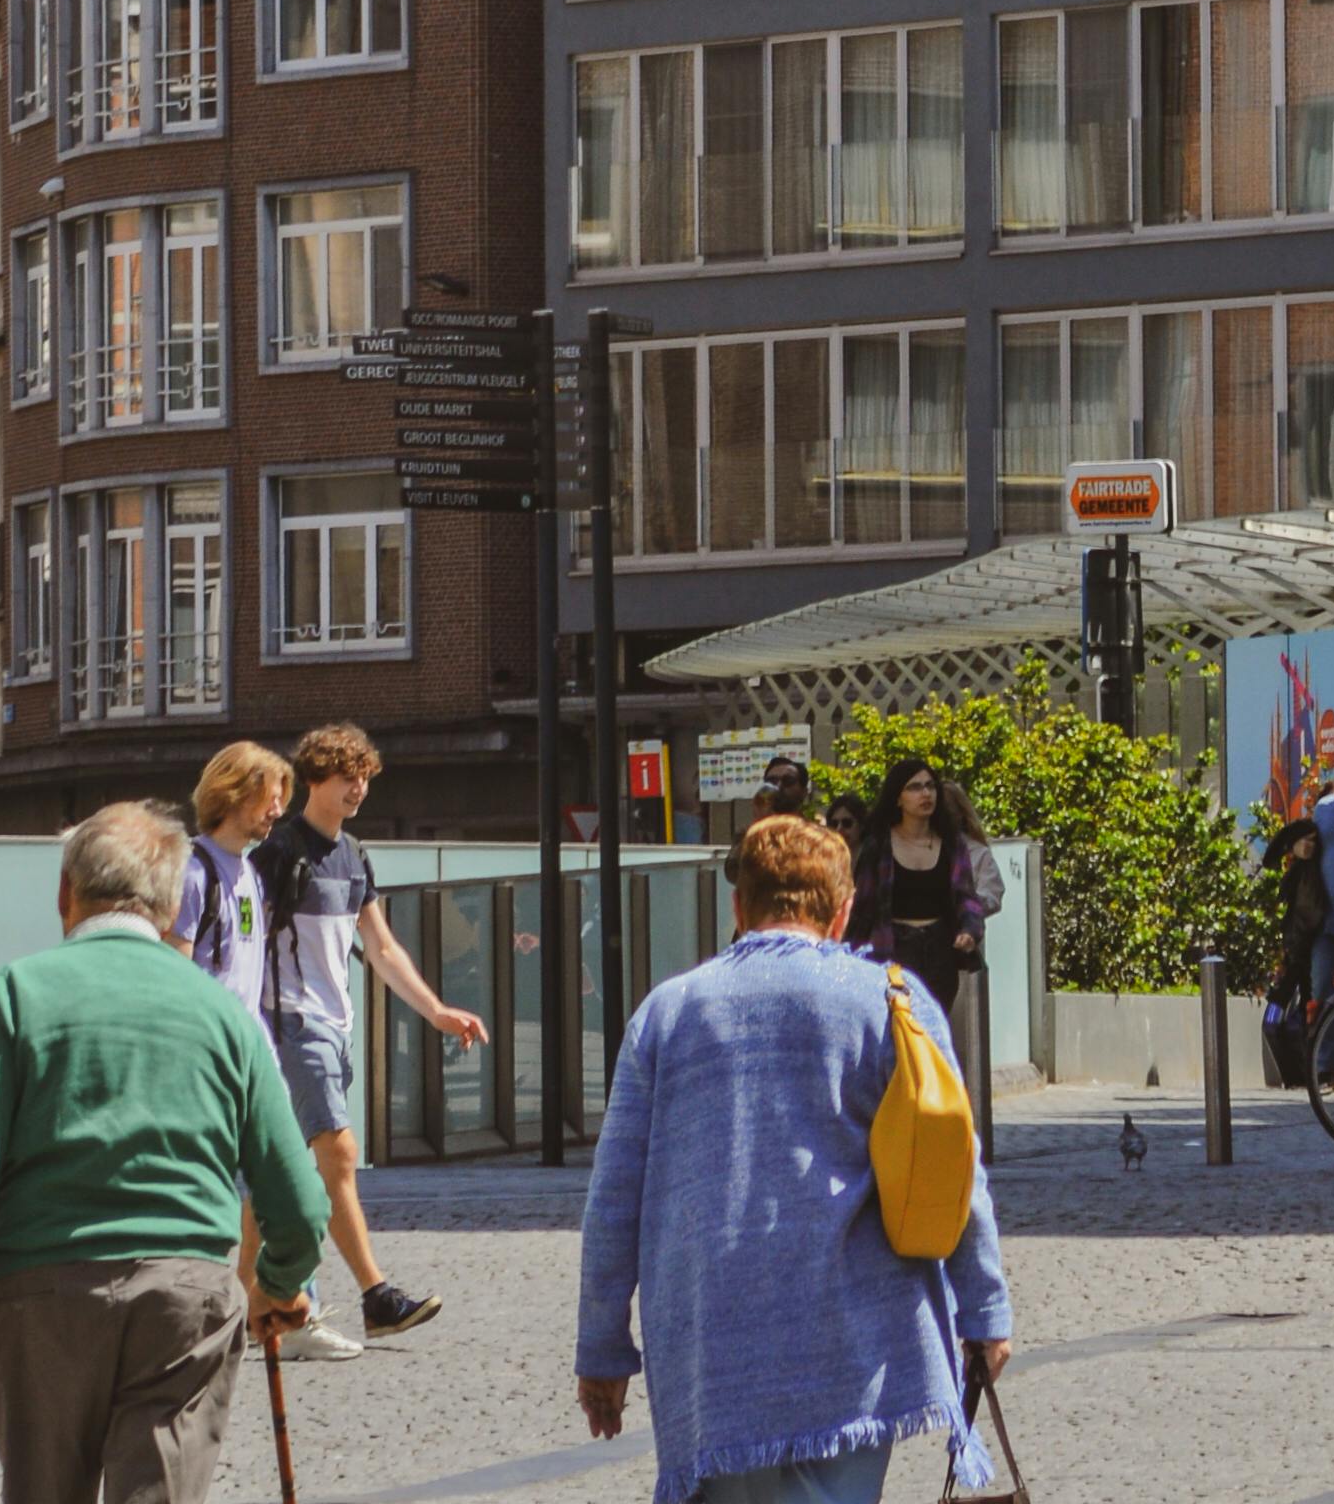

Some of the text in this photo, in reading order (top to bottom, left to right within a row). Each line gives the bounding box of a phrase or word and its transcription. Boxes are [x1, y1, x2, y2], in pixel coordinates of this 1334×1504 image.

[488, 315, 517, 328] POORT
[400, 343, 503, 358] UNIVERSITEITSHAL
[404, 372, 478, 386] JEUGDCENTRUM
[480, 374, 517, 388] VLEUGEL
[400, 402, 473, 417] OUDE MARKT
[403, 431, 505, 447] GROOT BEGIJNHOF
[401, 461, 461, 475] KRUIDTUIN
[1078, 479, 1152, 497] FAIRTRADE
[406, 492, 479, 506] VISIT LEUVEN
[1079, 497, 1150, 514] GEMEENTE
